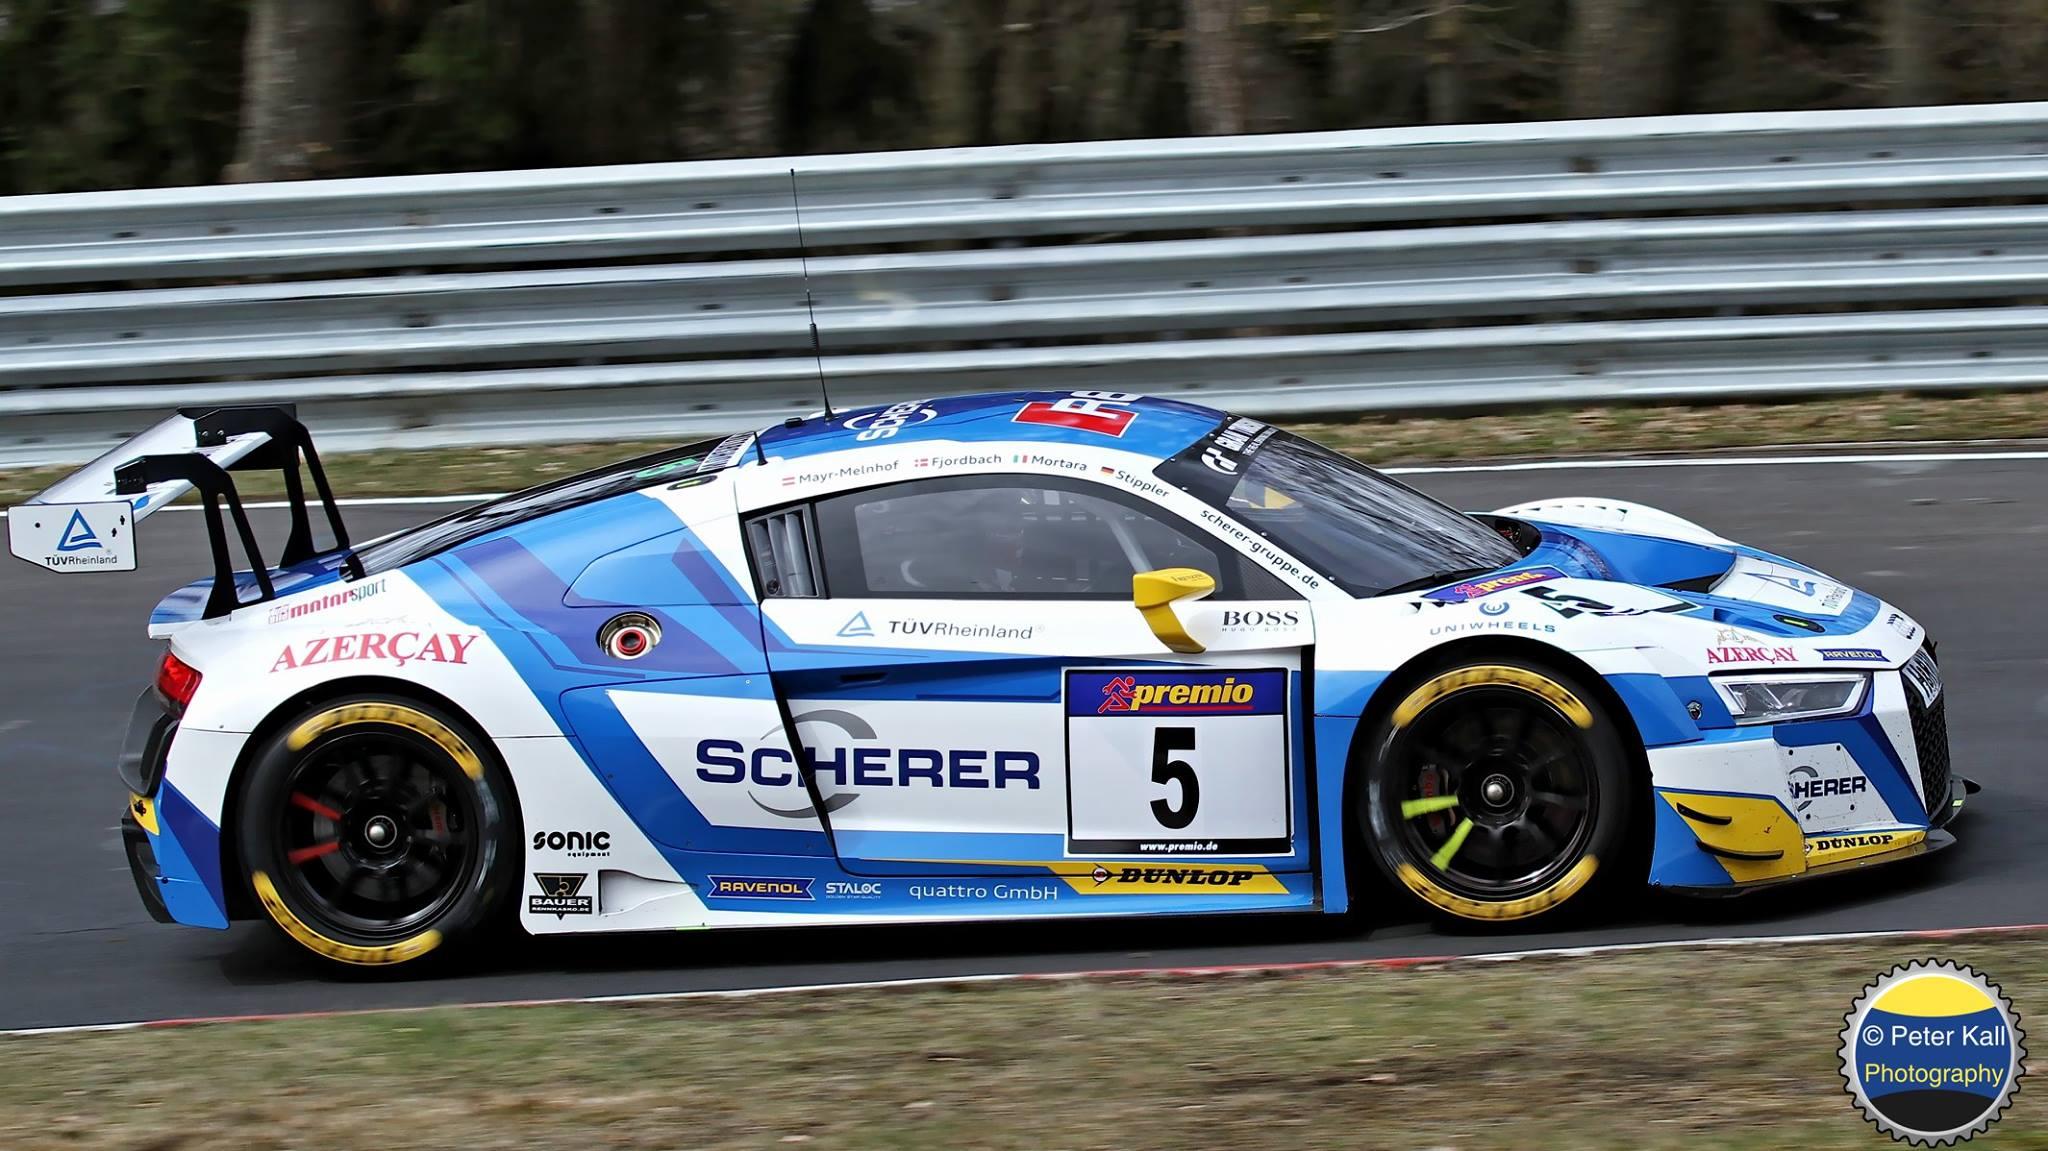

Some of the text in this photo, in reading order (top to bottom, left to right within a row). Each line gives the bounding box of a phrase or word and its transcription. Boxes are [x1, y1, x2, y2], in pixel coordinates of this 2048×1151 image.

[799, 454, 1169, 498] Mayr-Melnhof Fjordbach Mortara Stippler
[1200, 508, 1319, 590] scherer-gruppe.de
[1223, 611, 1298, 626] BOSS
[1430, 621, 1556, 636] UNIWHEELS
[269, 632, 479, 673] AZERÇAY
[1706, 647, 1799, 664] AZERÇAY
[1130, 677, 1254, 711] premio
[696, 739, 1041, 789] SCHERER
[1150, 727, 1200, 829] 5
[1140, 842, 1218, 852] www.premio.de
[1817, 835, 1894, 851] DUNLOP
[1117, 867, 1253, 886] DUNLOP
[720, 881, 803, 894] RAVENOL
[826, 882, 881, 894] STALOC
[909, 884, 1058, 900] quattro GmbH
[531, 898, 589, 906] BAUER
